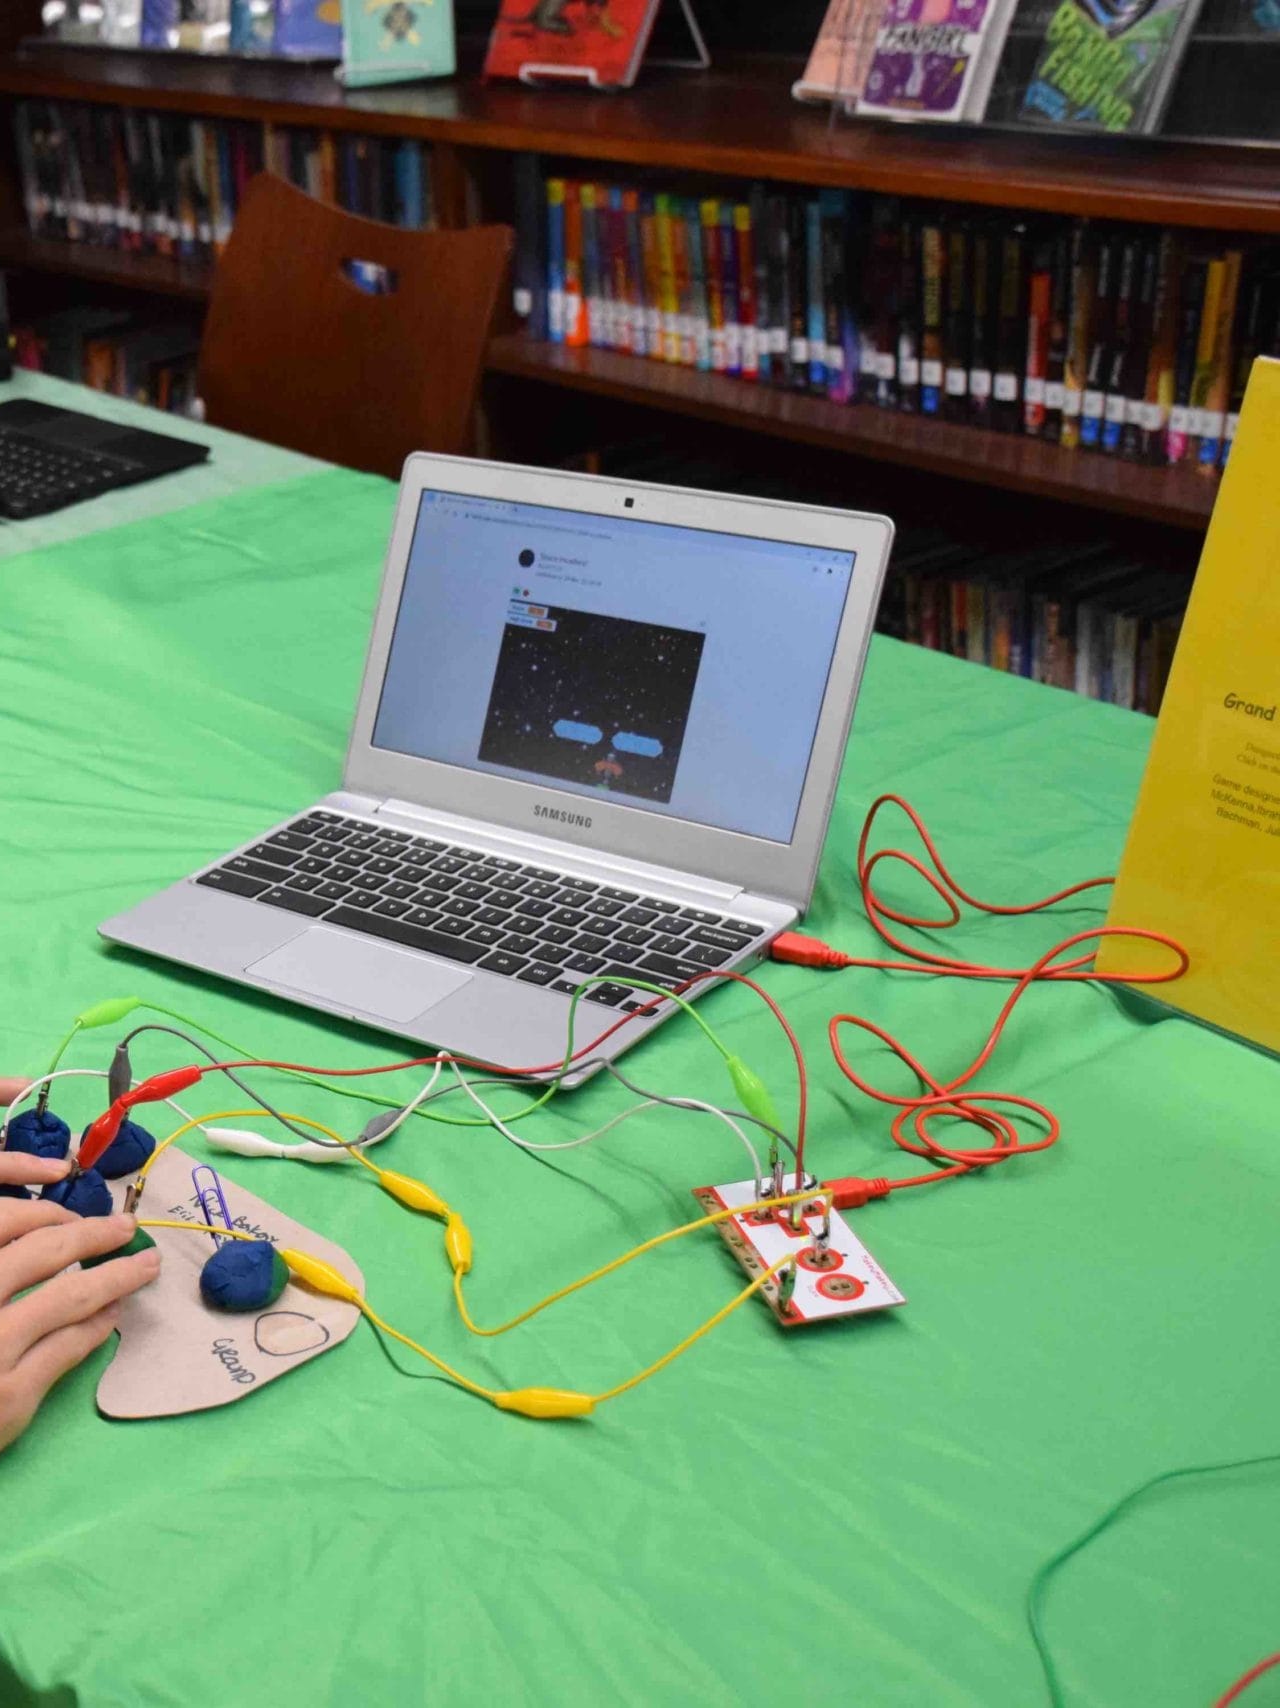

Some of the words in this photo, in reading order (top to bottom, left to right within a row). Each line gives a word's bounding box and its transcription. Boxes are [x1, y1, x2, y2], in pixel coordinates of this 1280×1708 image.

[1223, 692, 1277, 722] Grand
[1212, 773, 1242, 792] Game
[533, 804, 593, 829] SAMSUNG
[700, 929, 738, 944] backspace
